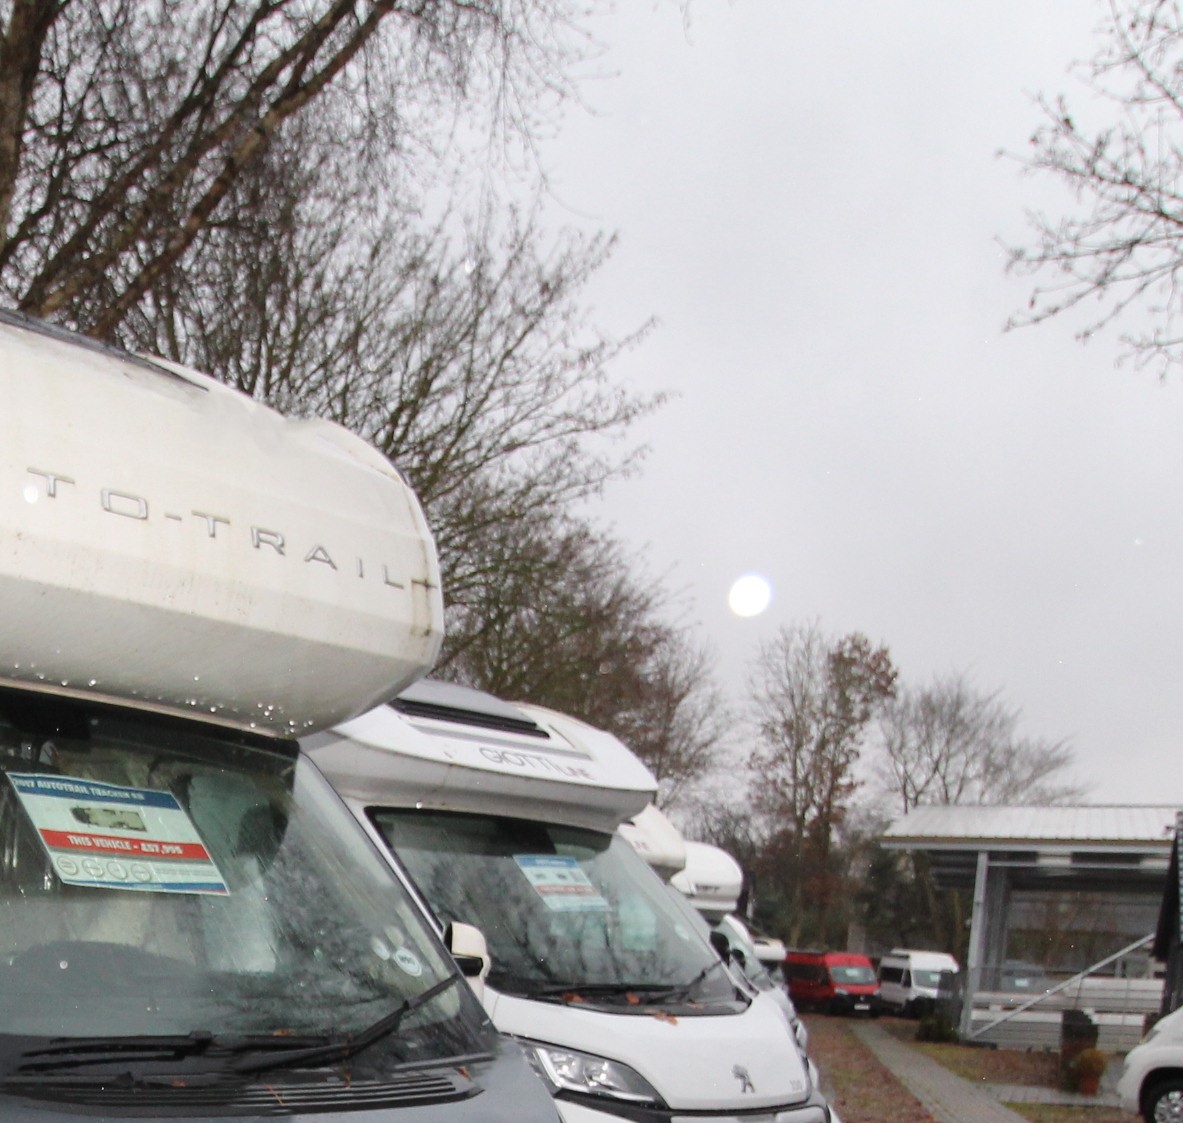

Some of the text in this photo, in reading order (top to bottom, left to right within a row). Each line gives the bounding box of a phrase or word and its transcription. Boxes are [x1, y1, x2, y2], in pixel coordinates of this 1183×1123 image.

[37, 780, 89, 795] AUTOTRAIL
[67, 835, 92, 847] THIS
[92, 837, 132, 850] VEHICLE
